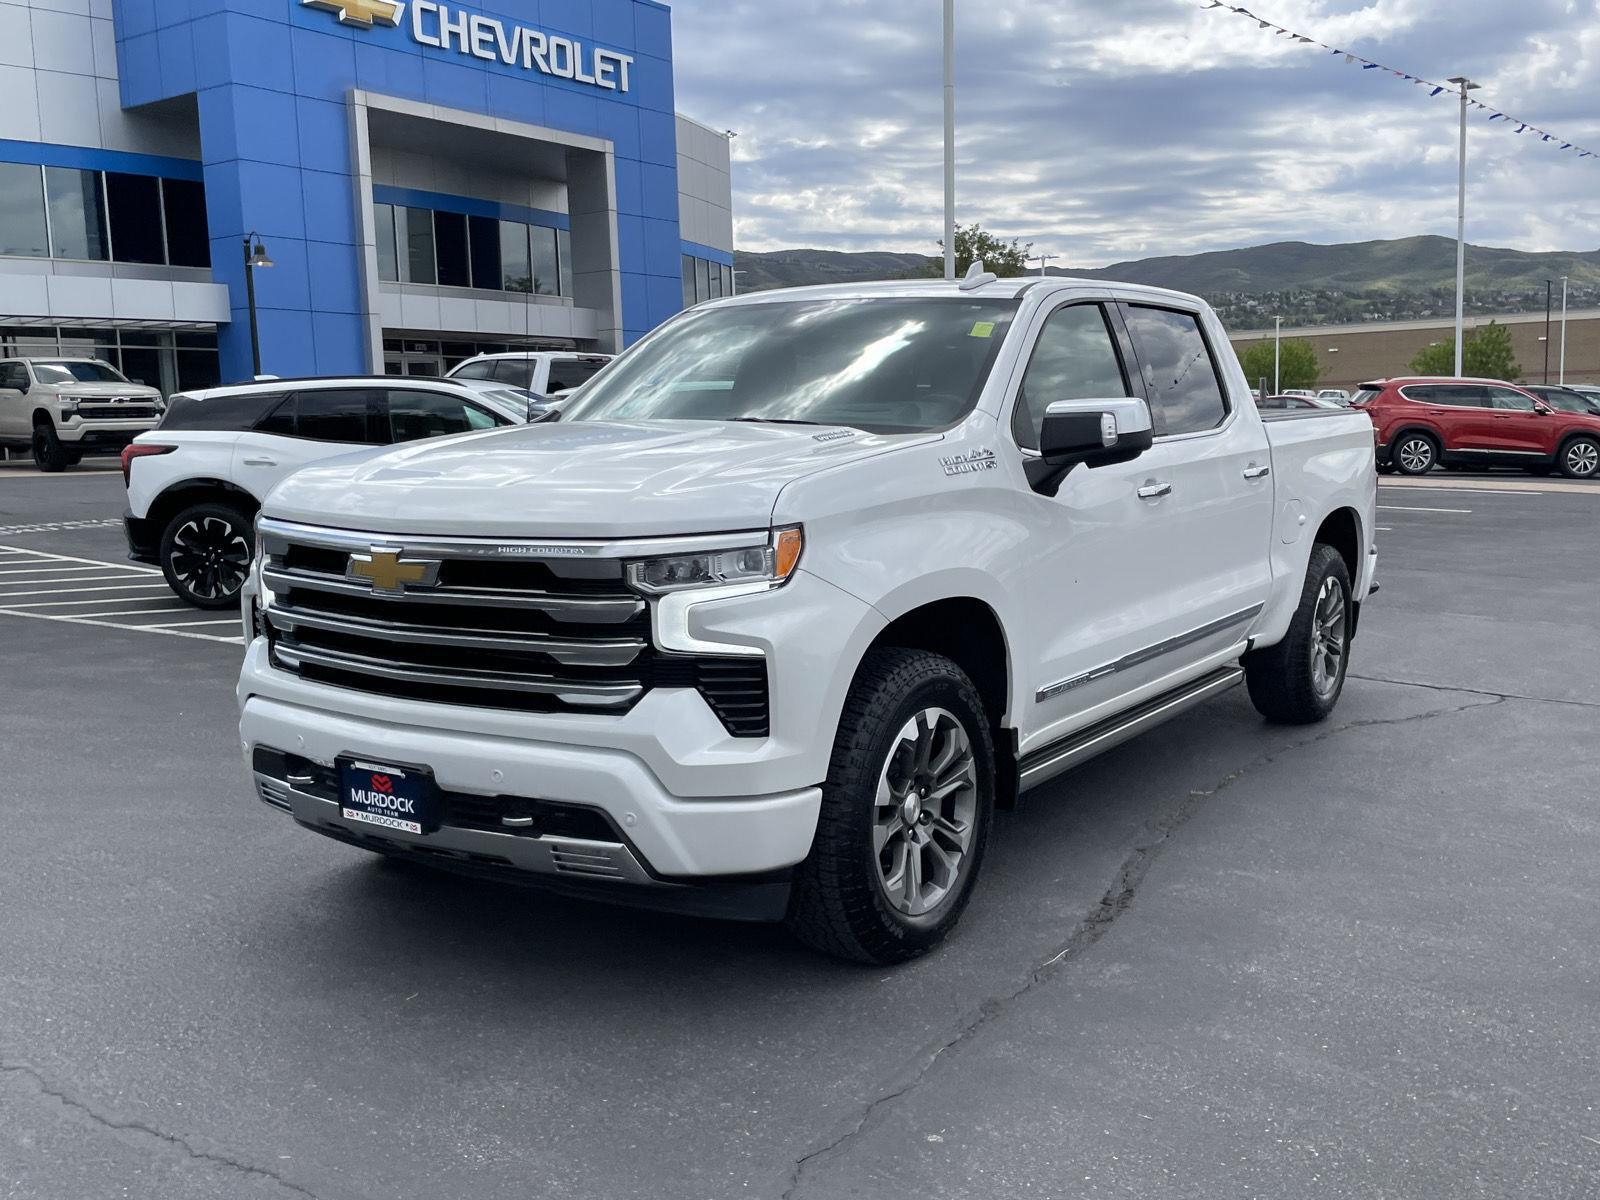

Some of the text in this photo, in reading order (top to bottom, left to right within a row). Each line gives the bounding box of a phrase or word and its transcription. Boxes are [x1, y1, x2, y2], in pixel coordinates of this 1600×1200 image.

[412, 0, 634, 92] CHEVROLET
[351, 787, 414, 813] MURDOCK
[361, 813, 403, 828] MURDOCK
[367, 806, 399, 817] AUTO TEAM
